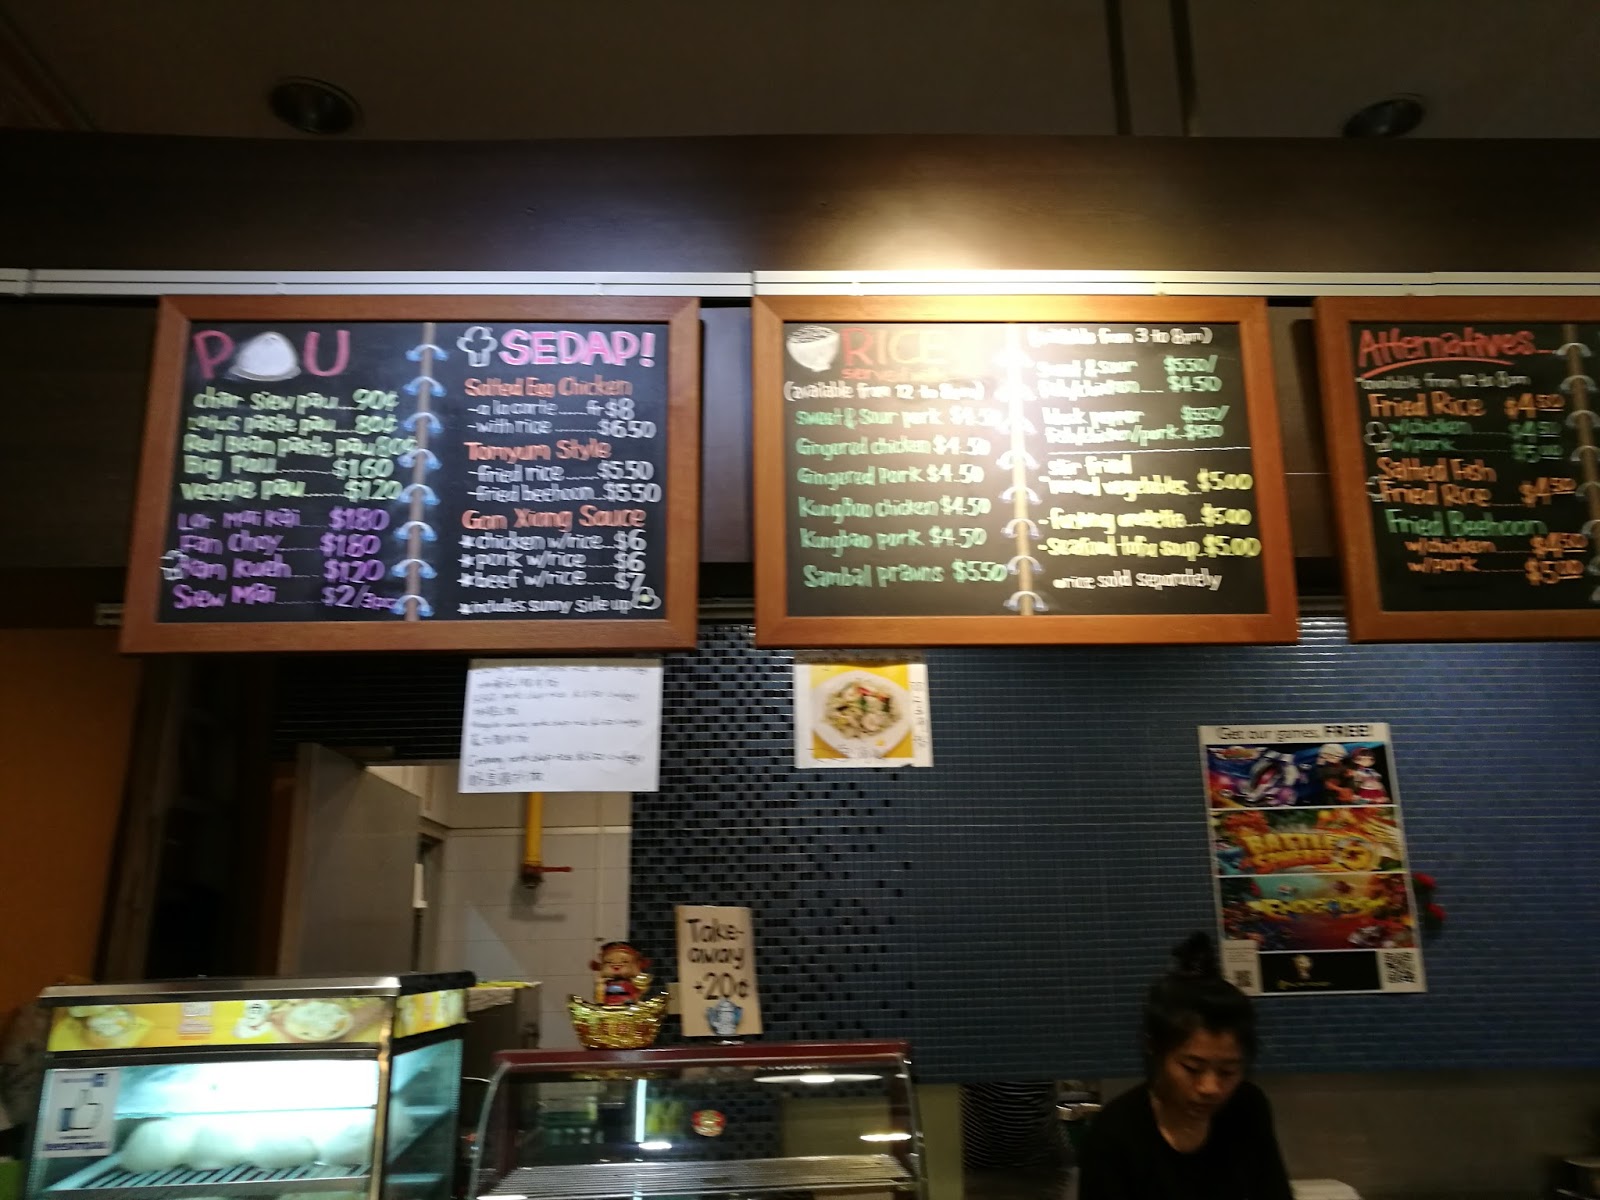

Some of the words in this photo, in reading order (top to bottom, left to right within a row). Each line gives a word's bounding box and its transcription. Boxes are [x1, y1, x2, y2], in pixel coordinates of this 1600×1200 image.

[1135, 327, 1149, 343] 3
[498, 328, 656, 368] SEDAP!
[464, 377, 525, 397] Salted
[525, 377, 555, 398] Egg
[558, 374, 634, 396] Chicken
[1368, 393, 1429, 417] Fried
[1431, 391, 1486, 416] Rice
[299, 415, 337, 436] pau
[515, 419, 553, 434] rice
[277, 436, 333, 457] paste
[555, 438, 612, 462] Style
[525, 466, 565, 482] rice
[1377, 457, 1448, 482] Salted
[1450, 458, 1497, 482] Fish
[1379, 480, 1439, 505] Fried
[1440, 483, 1492, 507] Rice
[578, 504, 647, 528] Sauce
[1385, 509, 1446, 536] Fried
[614, 528, 647, 551] $6
[614, 551, 646, 572] $6
[614, 571, 646, 592] $7
[803, 564, 872, 588] Sambal
[876, 563, 945, 588] prawns
[1218, 727, 1244, 741] Get
[1249, 729, 1270, 740] our
[688, 948, 745, 970] away
